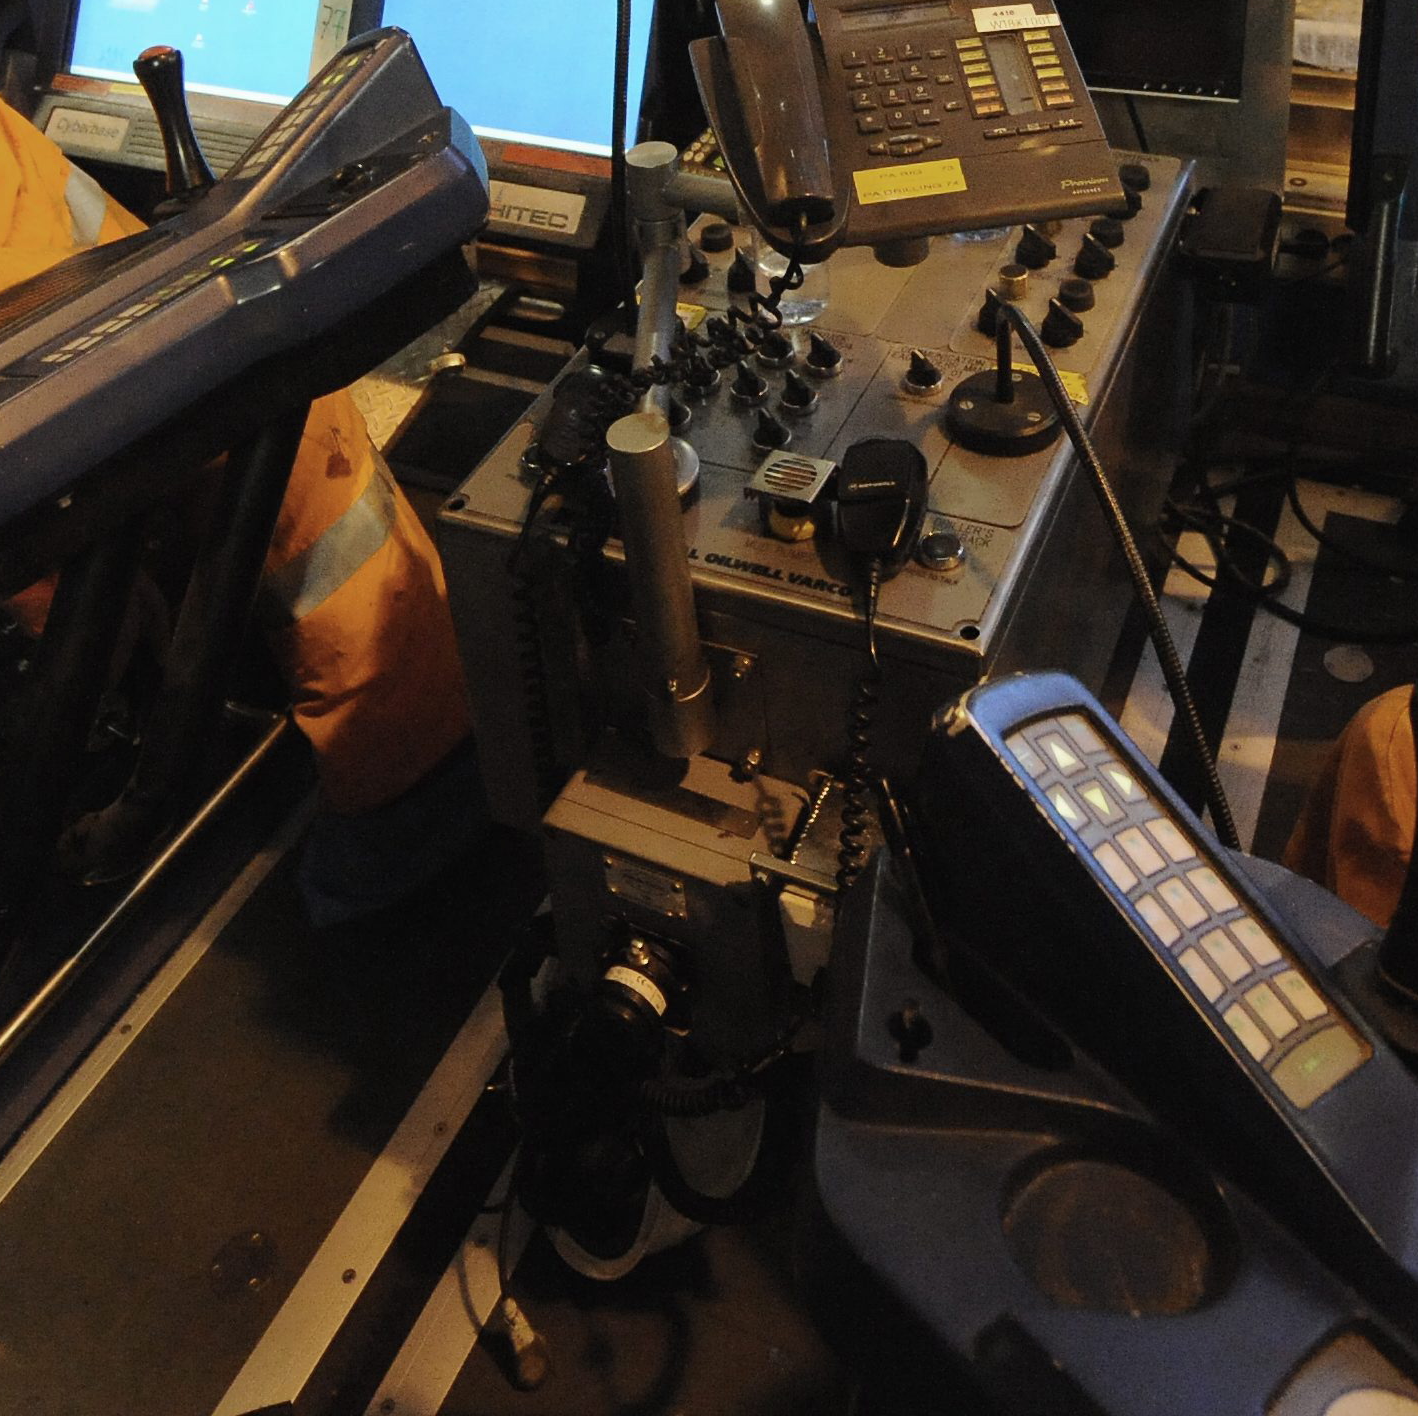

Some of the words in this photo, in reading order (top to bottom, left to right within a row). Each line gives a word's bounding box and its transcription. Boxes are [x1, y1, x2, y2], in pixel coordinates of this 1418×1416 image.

[489, 202, 569, 229] HITEC
[704, 551, 784, 582] OILWELL
[786, 571, 853, 597] VARCO
